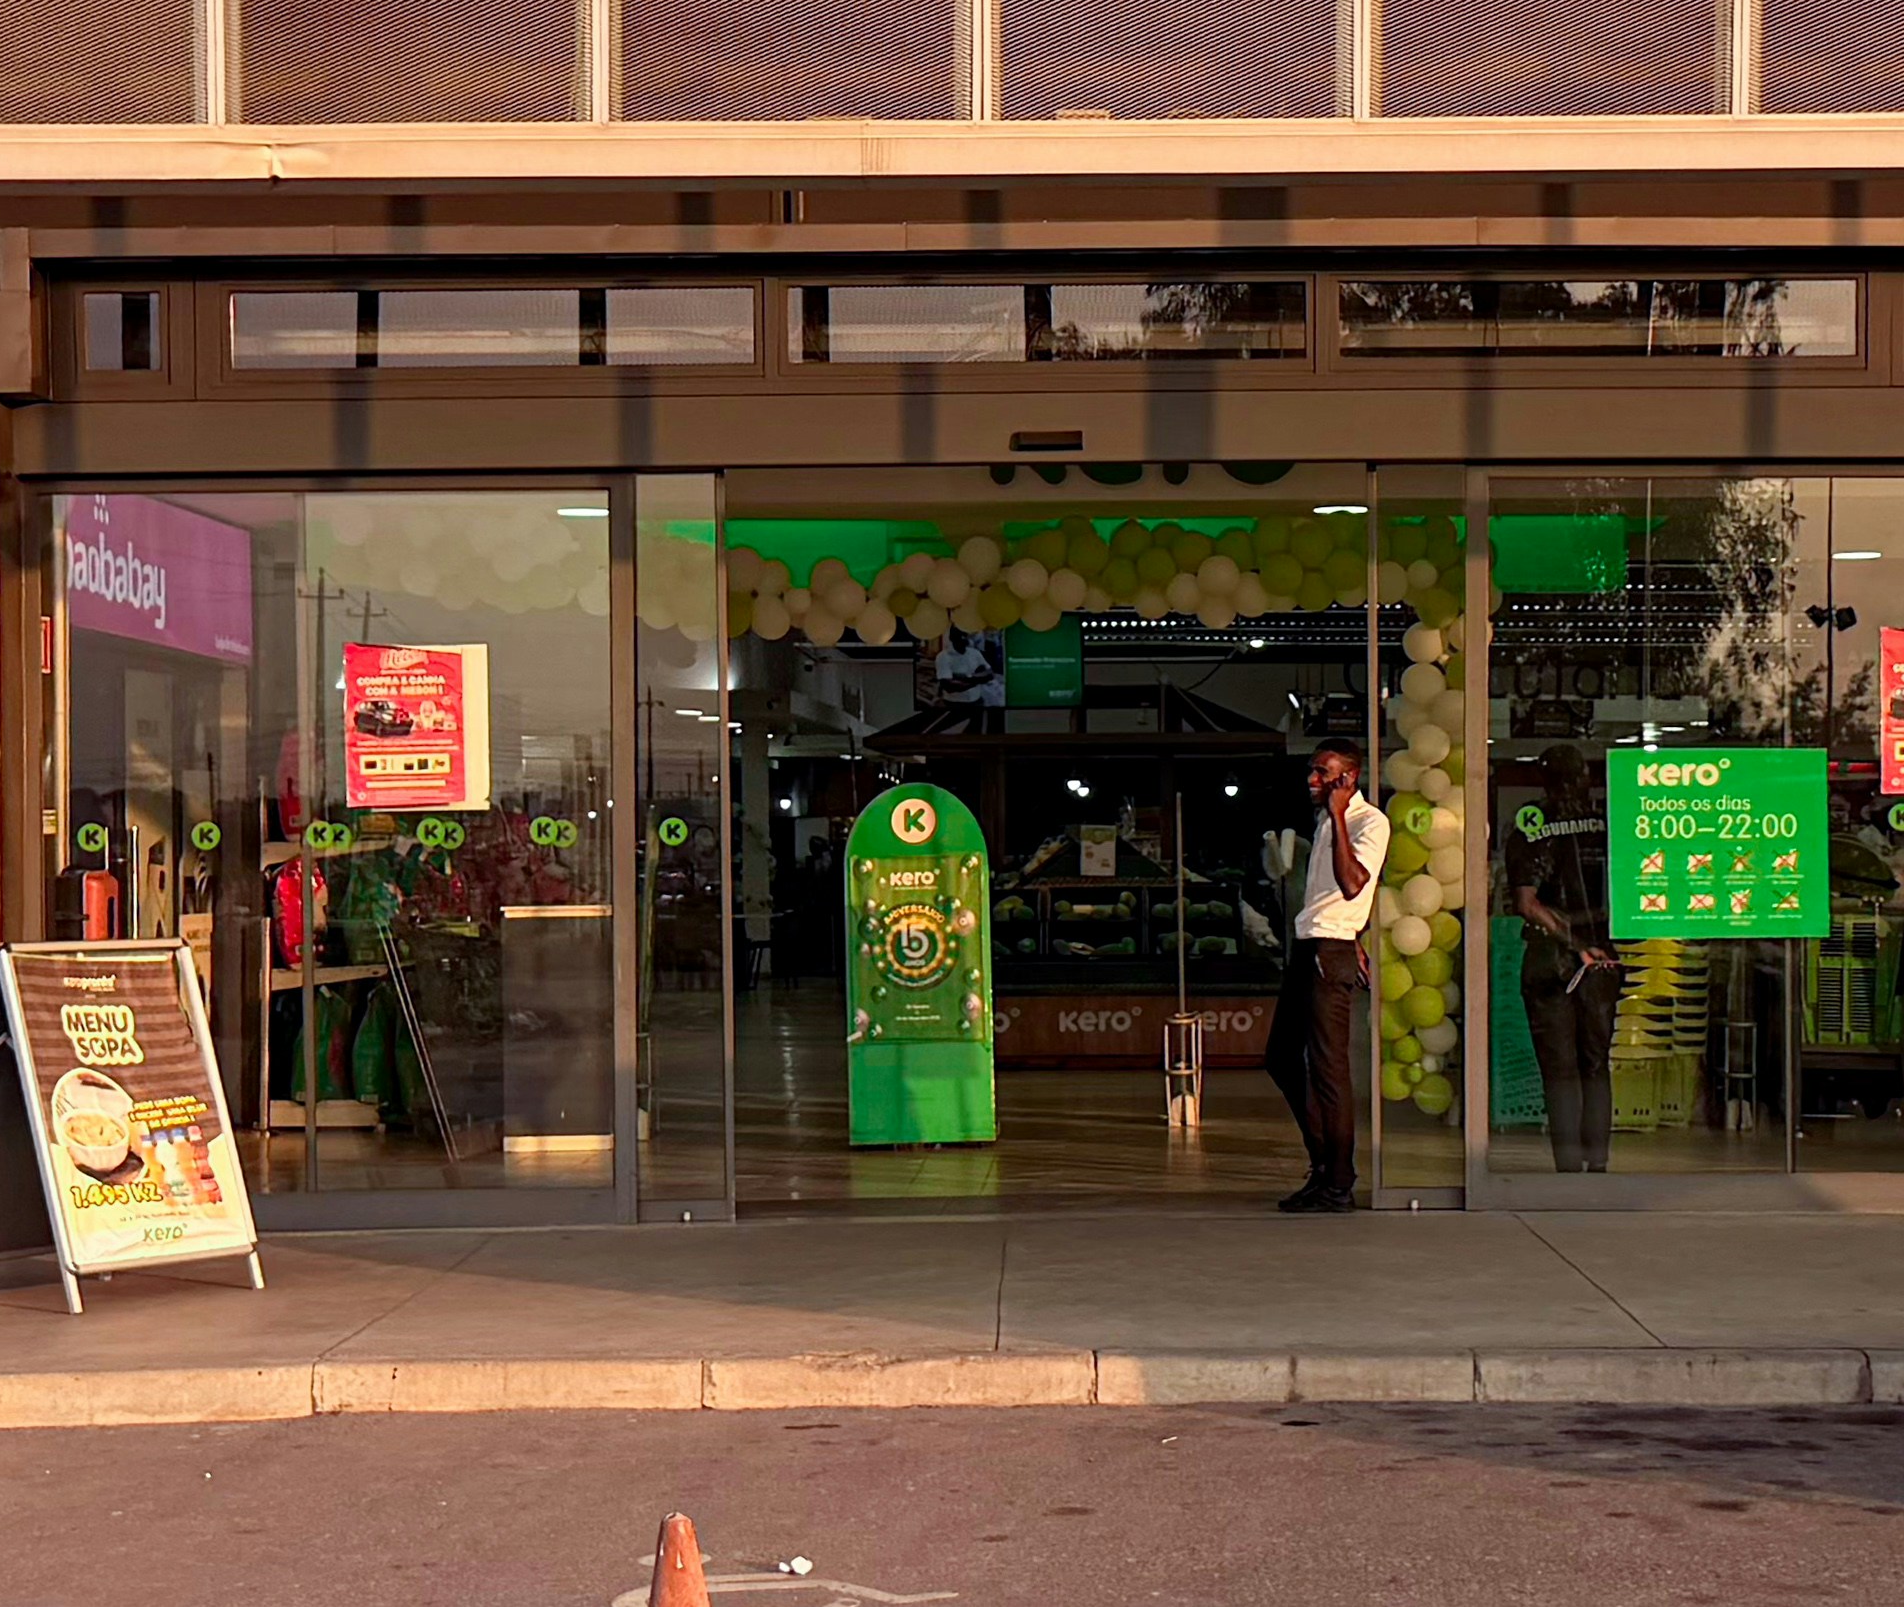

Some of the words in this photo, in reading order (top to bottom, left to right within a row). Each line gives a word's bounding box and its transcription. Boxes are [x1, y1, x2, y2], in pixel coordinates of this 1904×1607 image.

[1639, 796, 1687, 811] Todos
[1692, 799, 1712, 811] os
[1716, 795, 1751, 811] dias
[901, 925, 929, 958] 15
[66, 1011, 128, 1033] MENU
[1201, 1010, 1253, 1032] ero
[77, 1037, 137, 1059] SOPA
[70, 1183, 130, 1209] 1.495
